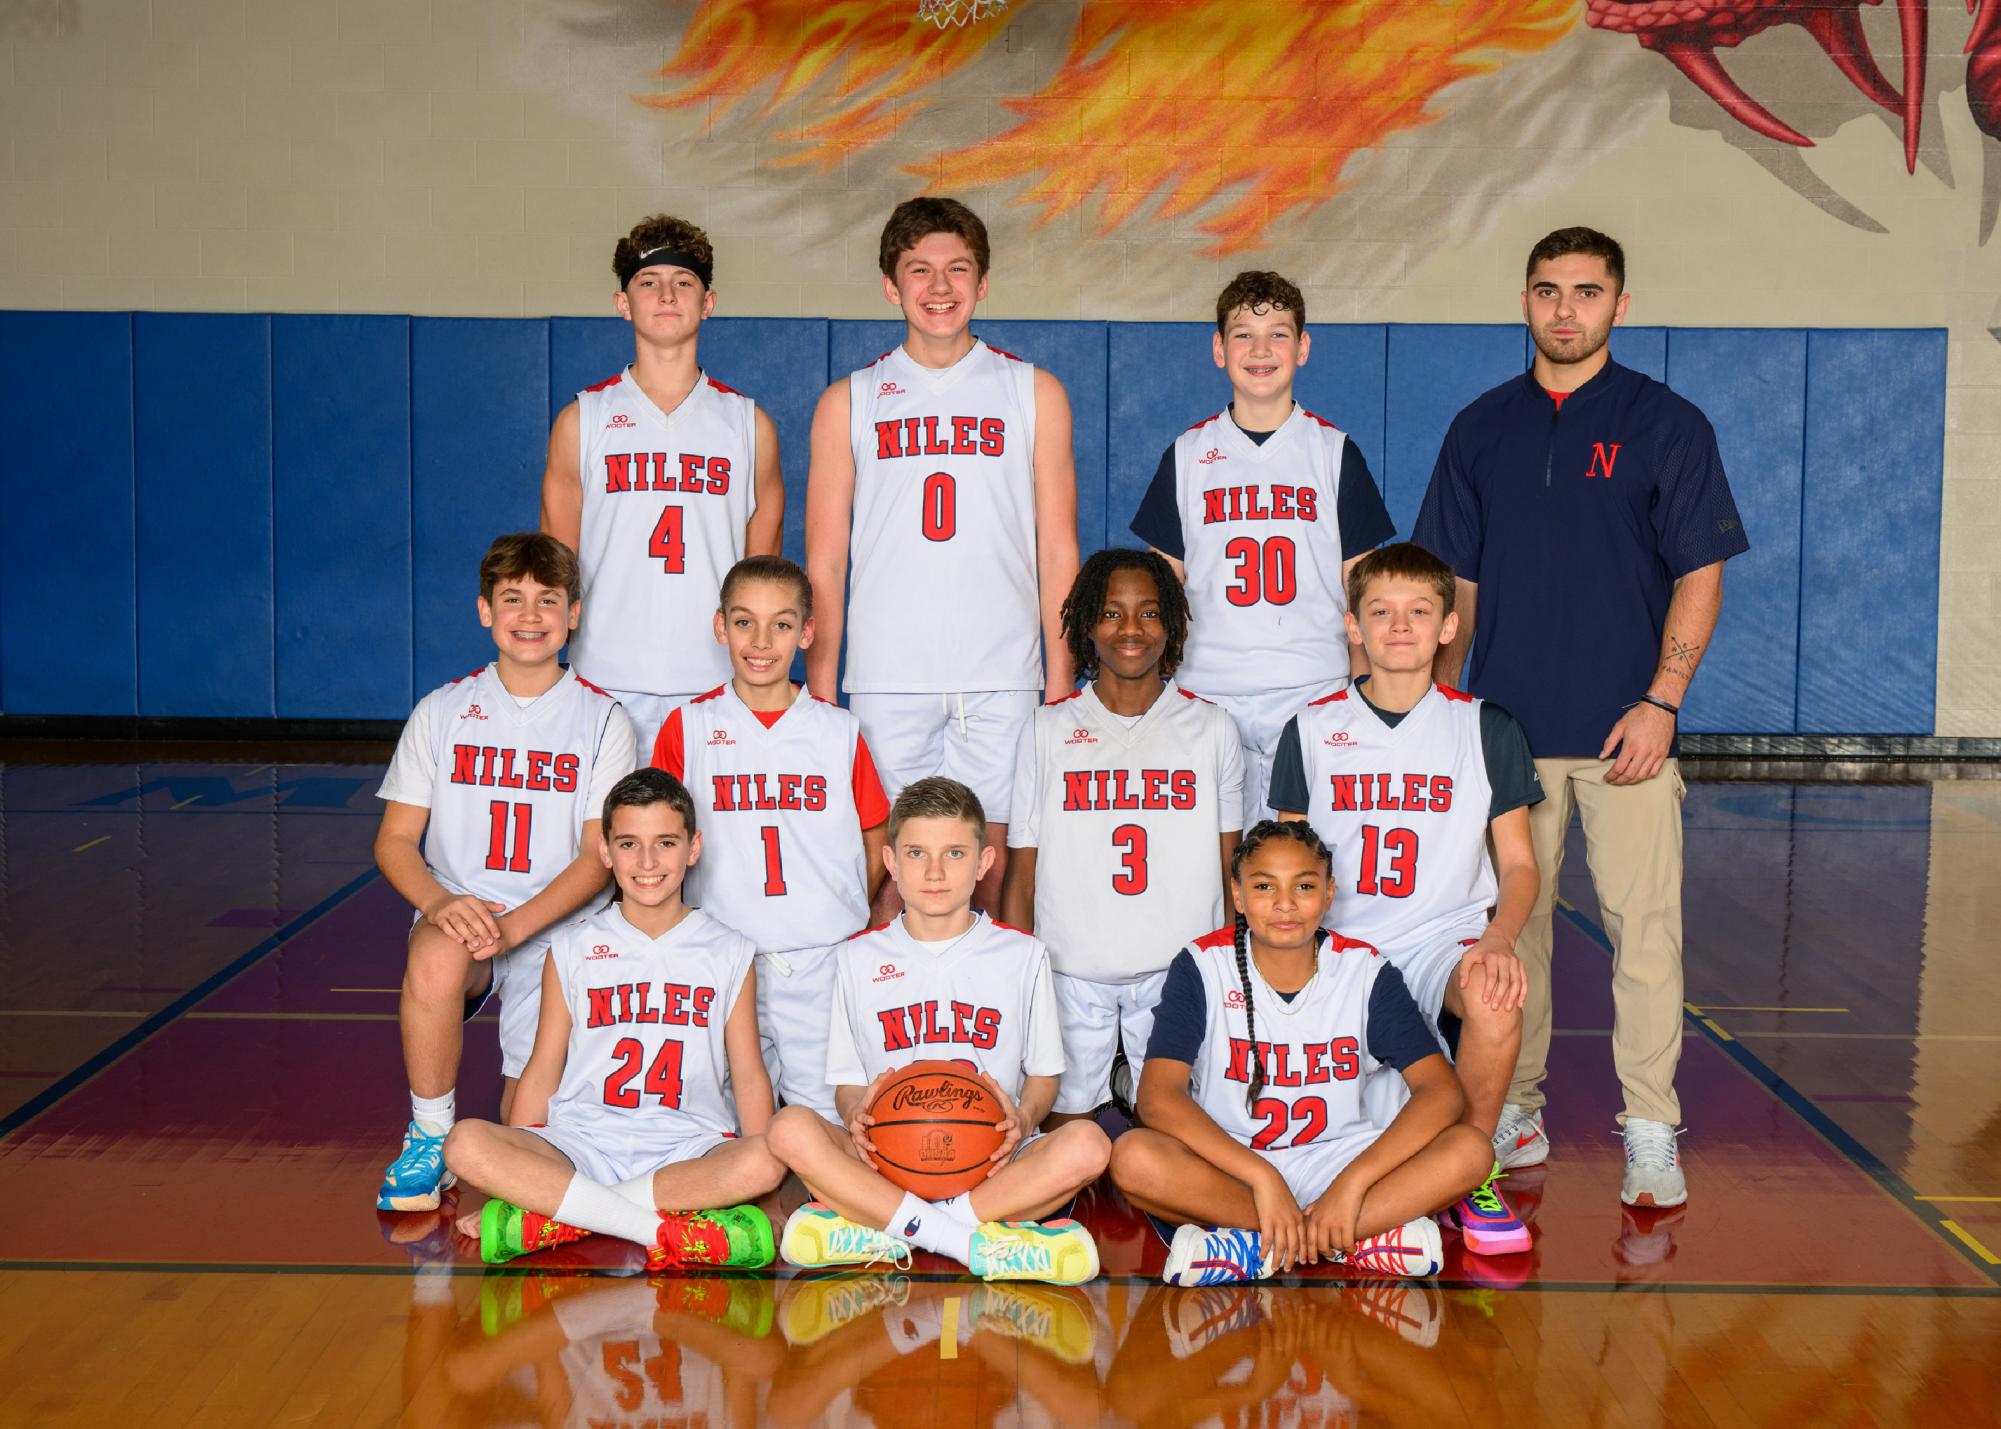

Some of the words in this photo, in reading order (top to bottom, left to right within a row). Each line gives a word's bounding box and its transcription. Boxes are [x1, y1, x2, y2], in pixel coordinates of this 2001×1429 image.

[875, 416, 1004, 459] NILES
[1585, 442, 1623, 478] N
[605, 453, 730, 495] NILES
[922, 472, 956, 541] 0
[1204, 485, 1317, 524] NILES
[649, 506, 685, 574] 4
[1226, 536, 1296, 607] 30
[451, 744, 579, 792] NILES
[1064, 770, 1196, 811] NILES
[713, 774, 826, 811] NILES
[1331, 774, 1453, 812] NILES
[486, 800, 532, 873] 11
[1112, 824, 1147, 895] 3
[761, 826, 787, 896] 1
[1357, 825, 1418, 898] 13
[872, 972, 905, 983] WOOTER
[587, 982, 716, 1028] NILES
[877, 1000, 1002, 1052] NILES
[604, 1038, 684, 1110] 24
[892, 1080, 983, 1110] Rawlings
[1251, 1096, 1327, 1151] 22
